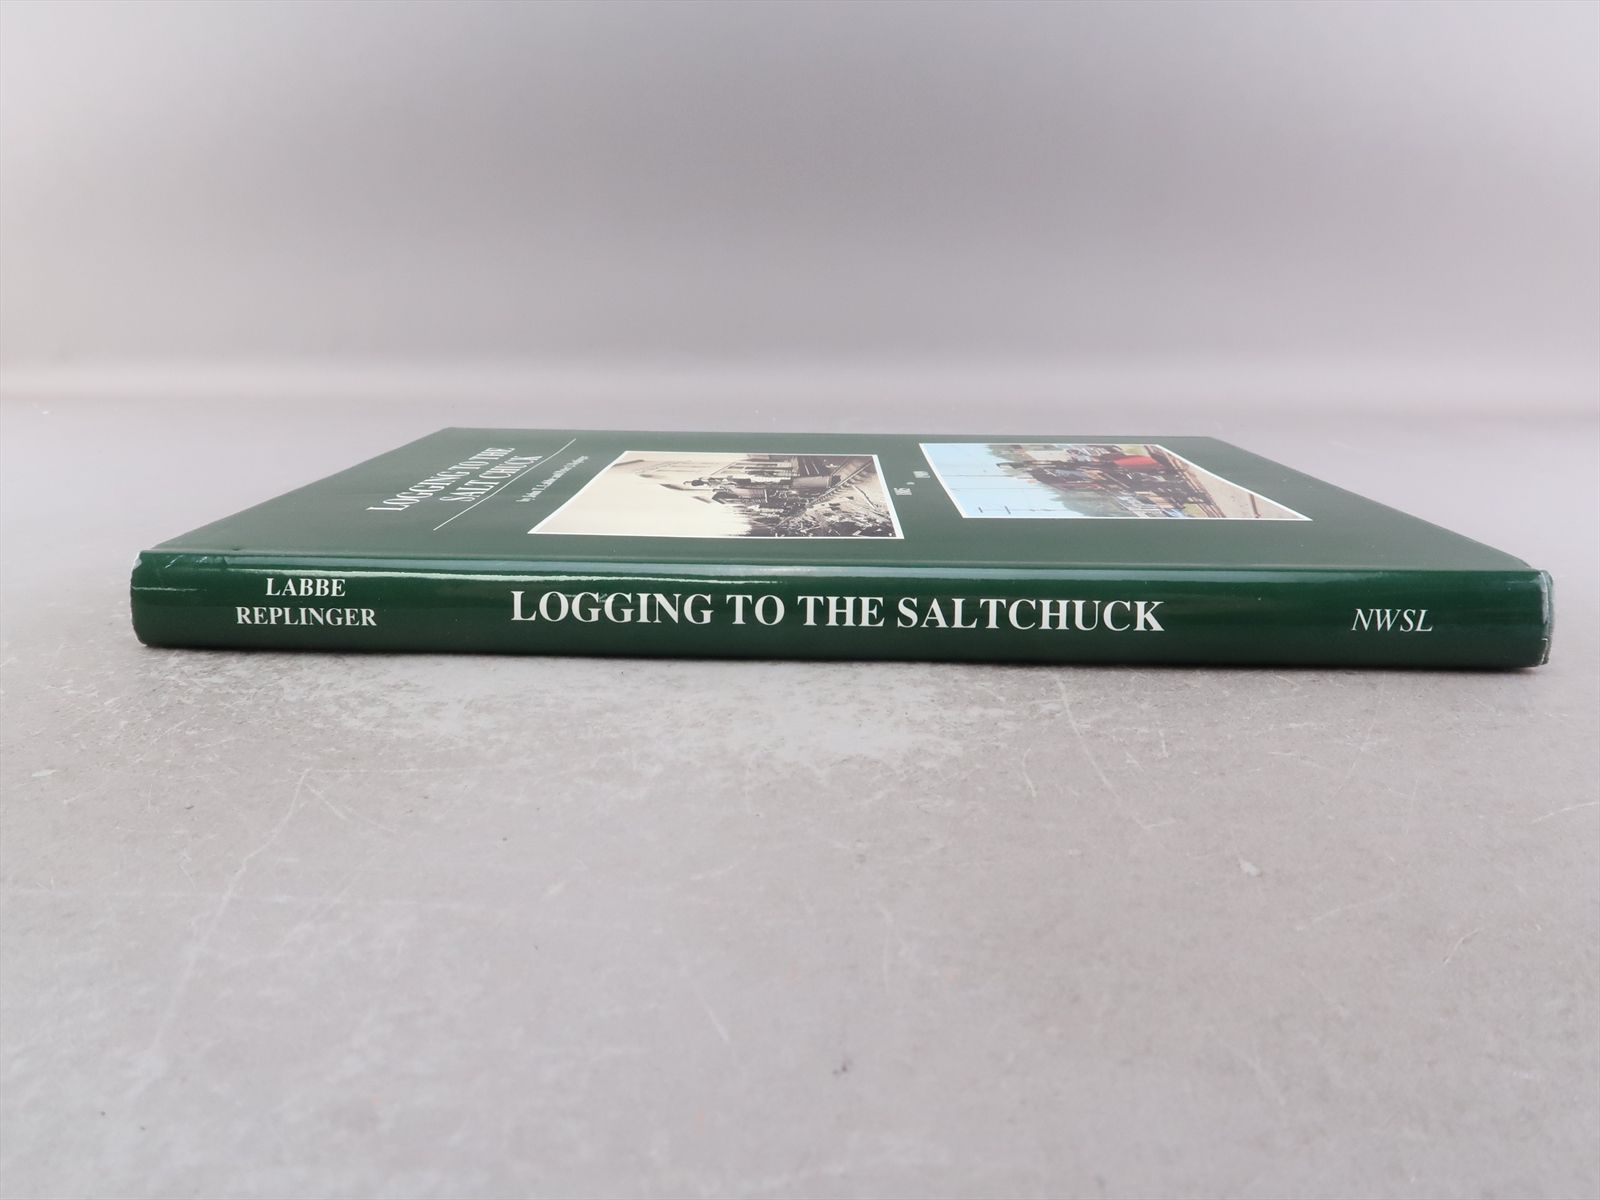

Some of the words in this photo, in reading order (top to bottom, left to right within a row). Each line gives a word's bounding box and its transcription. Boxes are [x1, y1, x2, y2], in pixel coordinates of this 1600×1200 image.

[468, 447, 515, 460] THE
[448, 461, 489, 470] TO
[439, 479, 500, 502] SALT
[478, 455, 543, 479] CHUCK
[366, 471, 470, 511] LOGGING
[266, 577, 346, 597] LABBE
[236, 606, 377, 626] REPLINGER
[511, 590, 713, 625] LOGGING
[727, 594, 785, 626] TO
[797, 595, 885, 627] THE
[897, 597, 1164, 632] SALTCHUCK
[1351, 608, 1433, 632] NWSL
